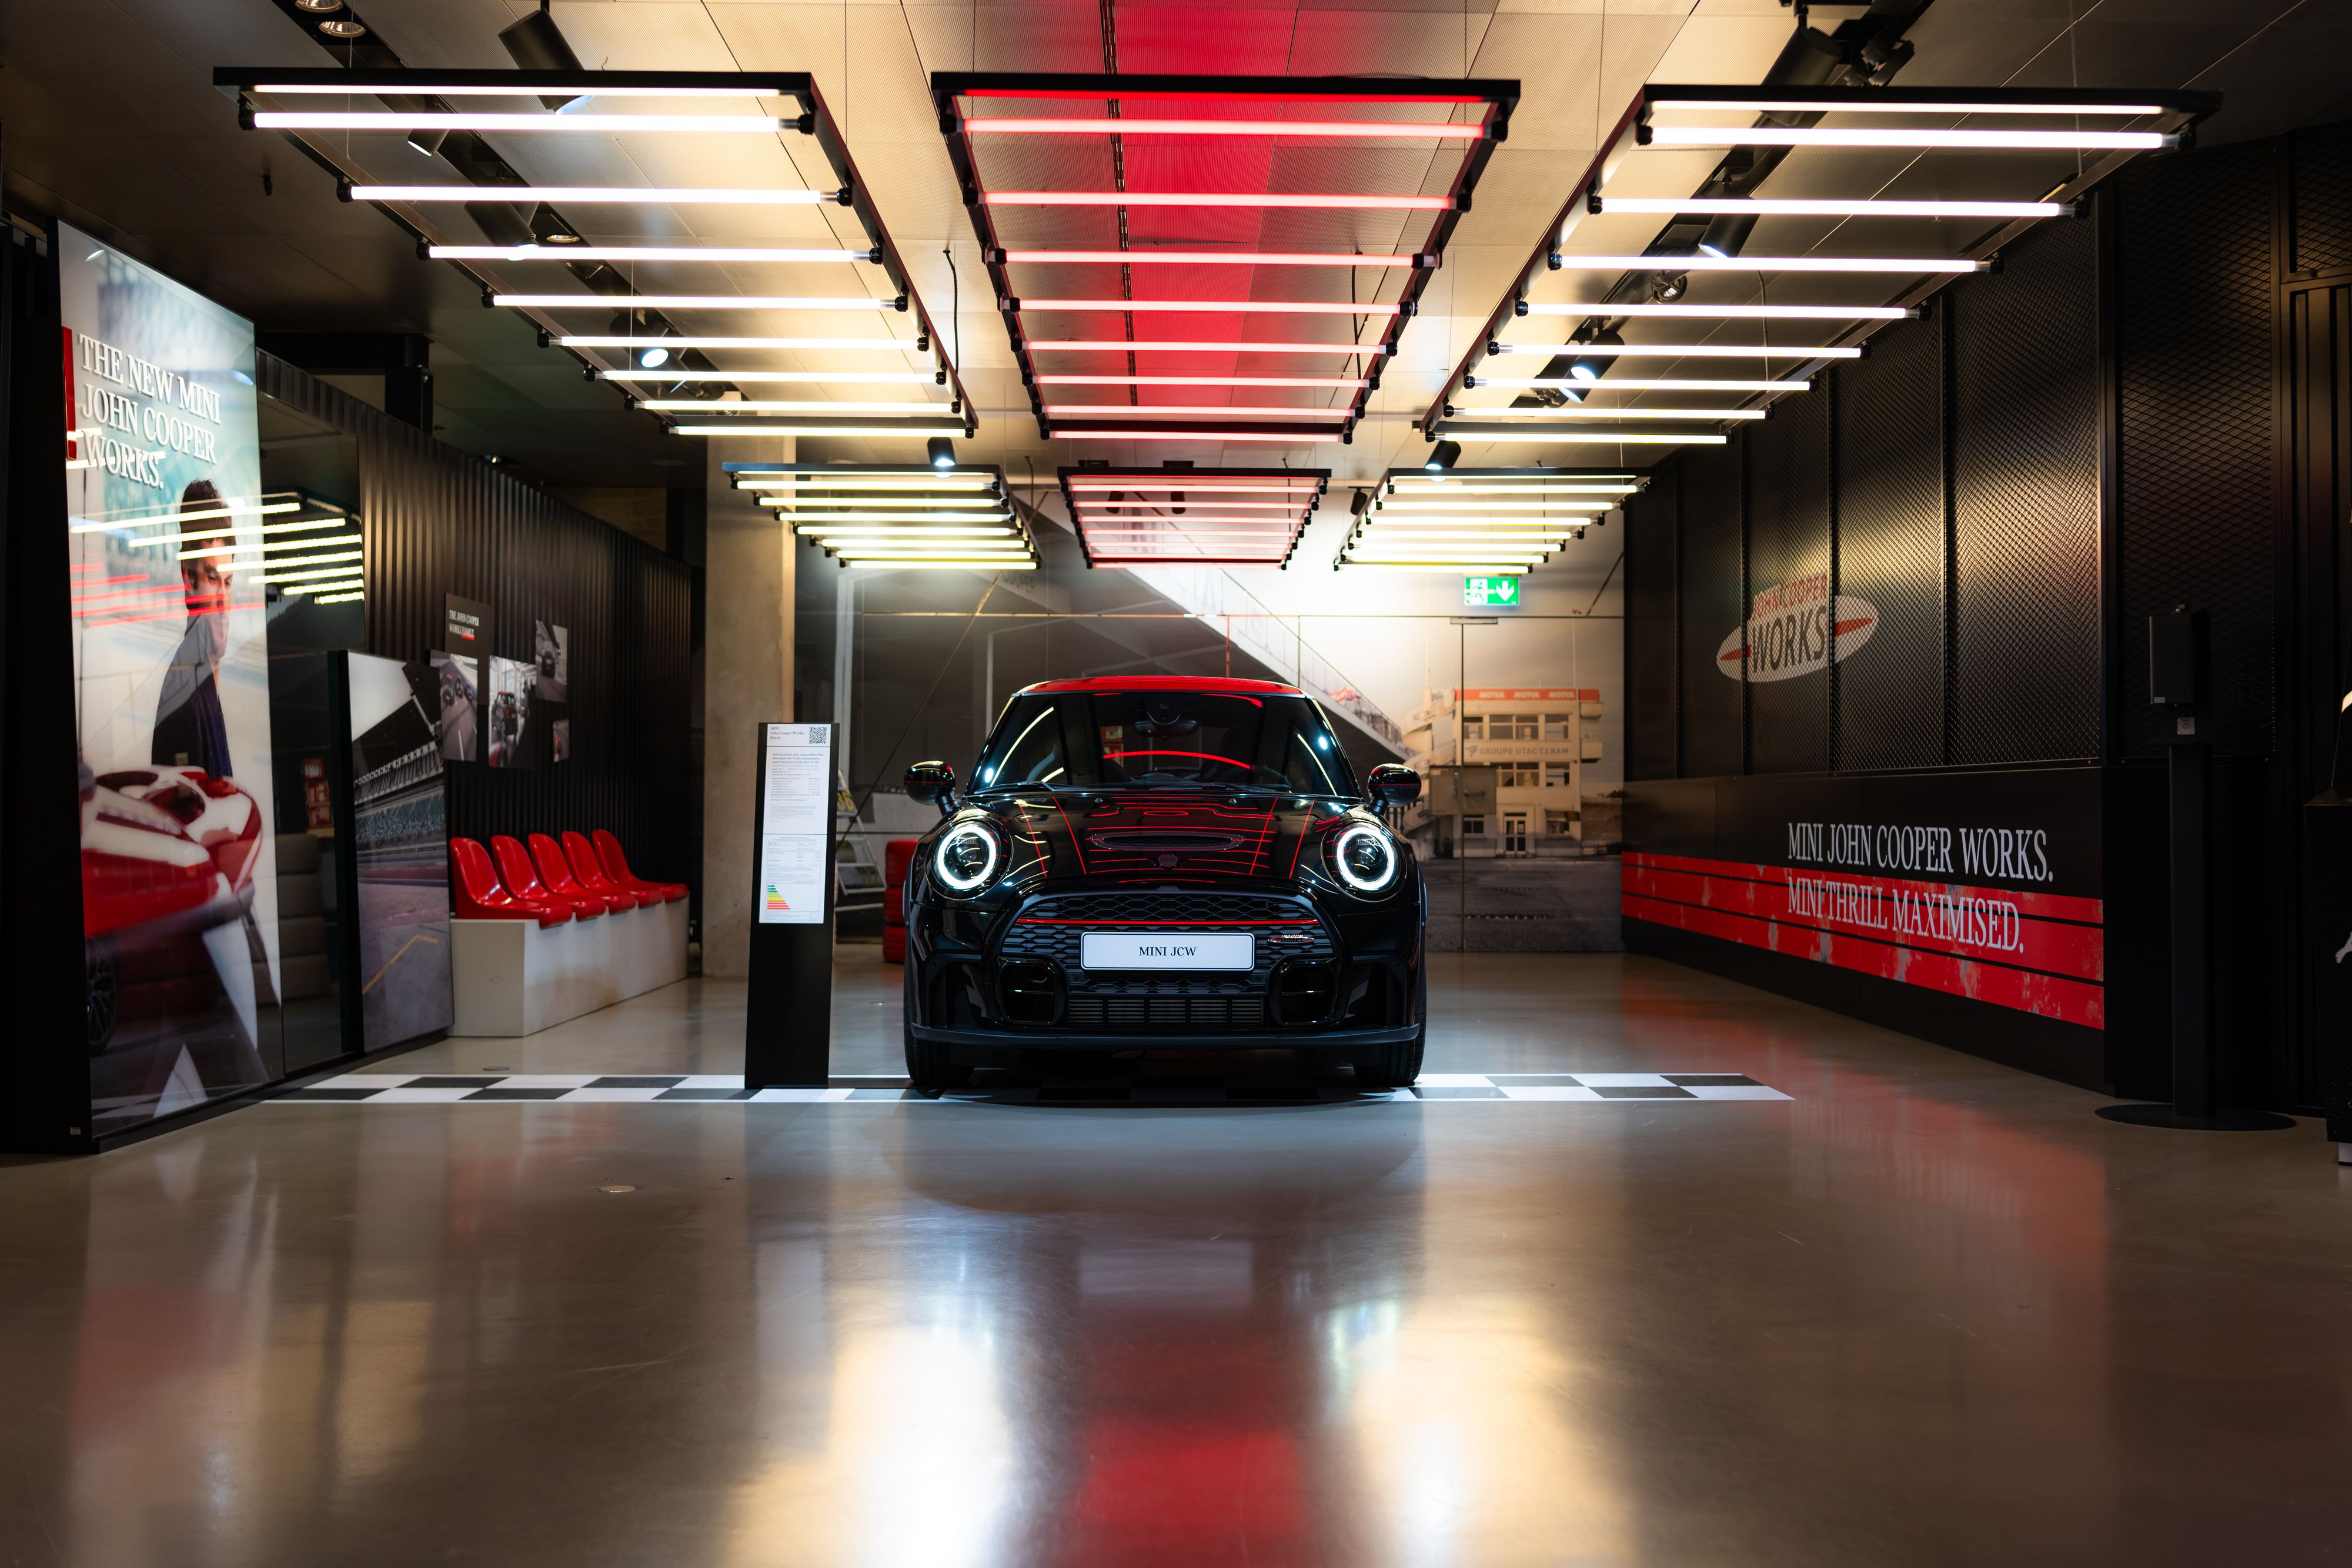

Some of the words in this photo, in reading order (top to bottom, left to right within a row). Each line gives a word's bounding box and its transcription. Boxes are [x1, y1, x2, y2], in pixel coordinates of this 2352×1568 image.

[79, 333, 123, 384] THE
[126, 354, 175, 403] NEW
[178, 376, 221, 424] MINI
[82, 383, 139, 435] JOHN
[143, 407, 218, 464] COOPER
[81, 429, 164, 489] WORKS.
[1752, 604, 1826, 673] WORKS
[1788, 822, 1823, 862] MINI
[1828, 823, 1872, 867] JOHN
[1876, 825, 1954, 873] COOPER
[1959, 827, 2053, 882] WORKS.
[1788, 876, 1823, 918] MINI
[1826, 880, 1887, 930] THRILL
[1892, 888, 2024, 954] MAXIMISED.
[1139, 947, 1168, 956] MINI
[1170, 947, 1197, 956] JCW
